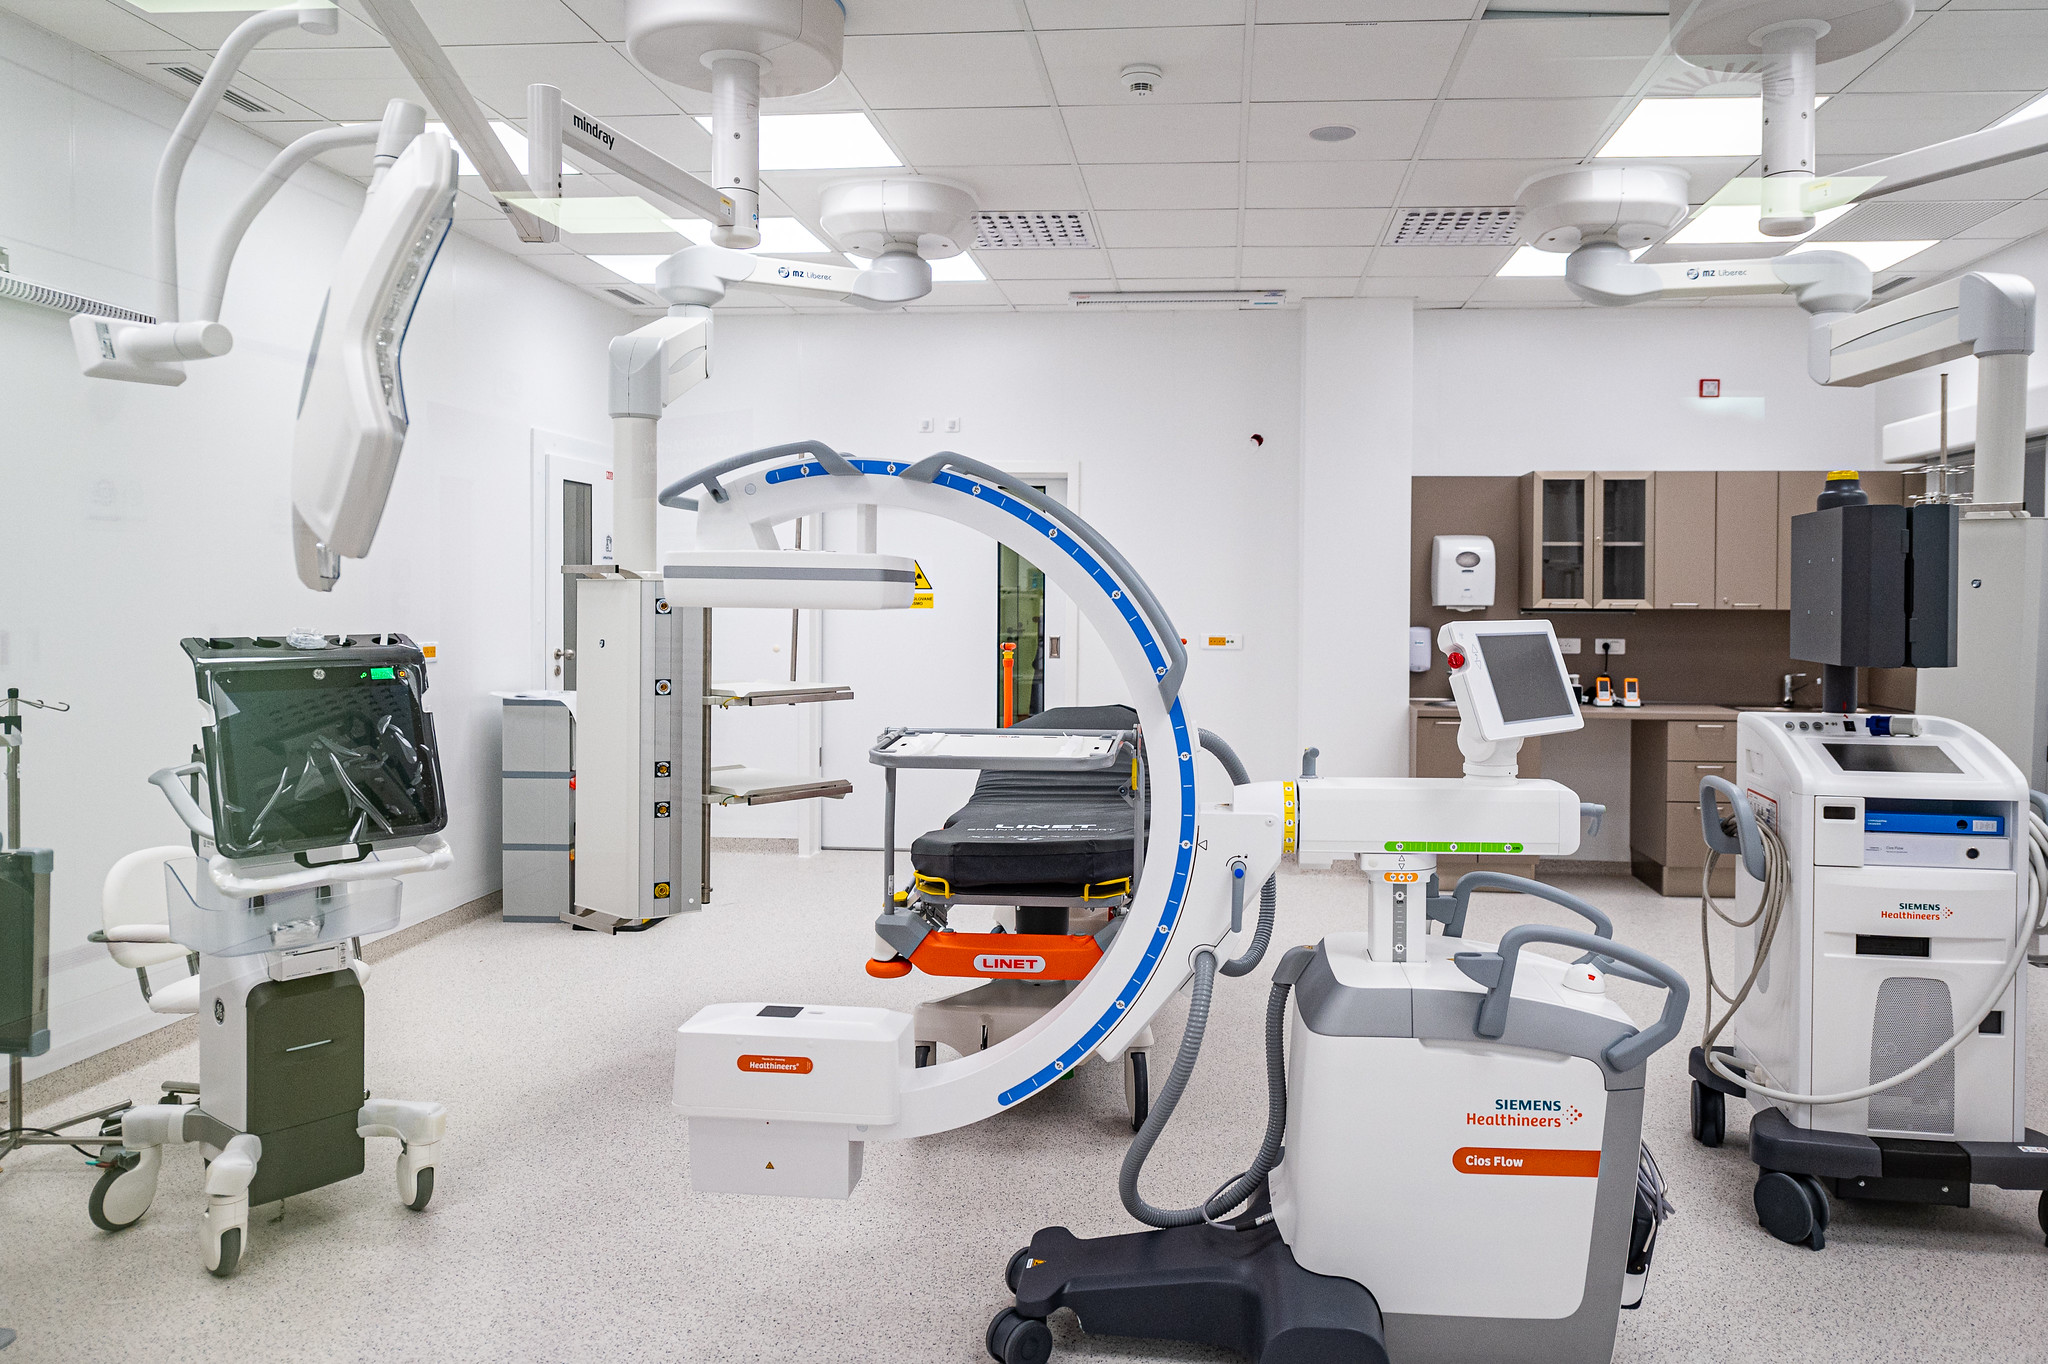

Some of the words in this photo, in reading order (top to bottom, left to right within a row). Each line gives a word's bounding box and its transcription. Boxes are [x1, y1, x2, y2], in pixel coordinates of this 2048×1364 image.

[573, 114, 615, 151] mindray
[1899, 902, 1941, 911] SIEMENS
[1881, 910, 1941, 921] Healthineers
[982, 958, 1038, 969] LINET
[1495, 1099, 1562, 1111] SIEMENS
[1466, 1112, 1562, 1128] Healthineers
[1465, 1155, 1491, 1167] Cios
[1493, 1156, 1523, 1167] Flow
